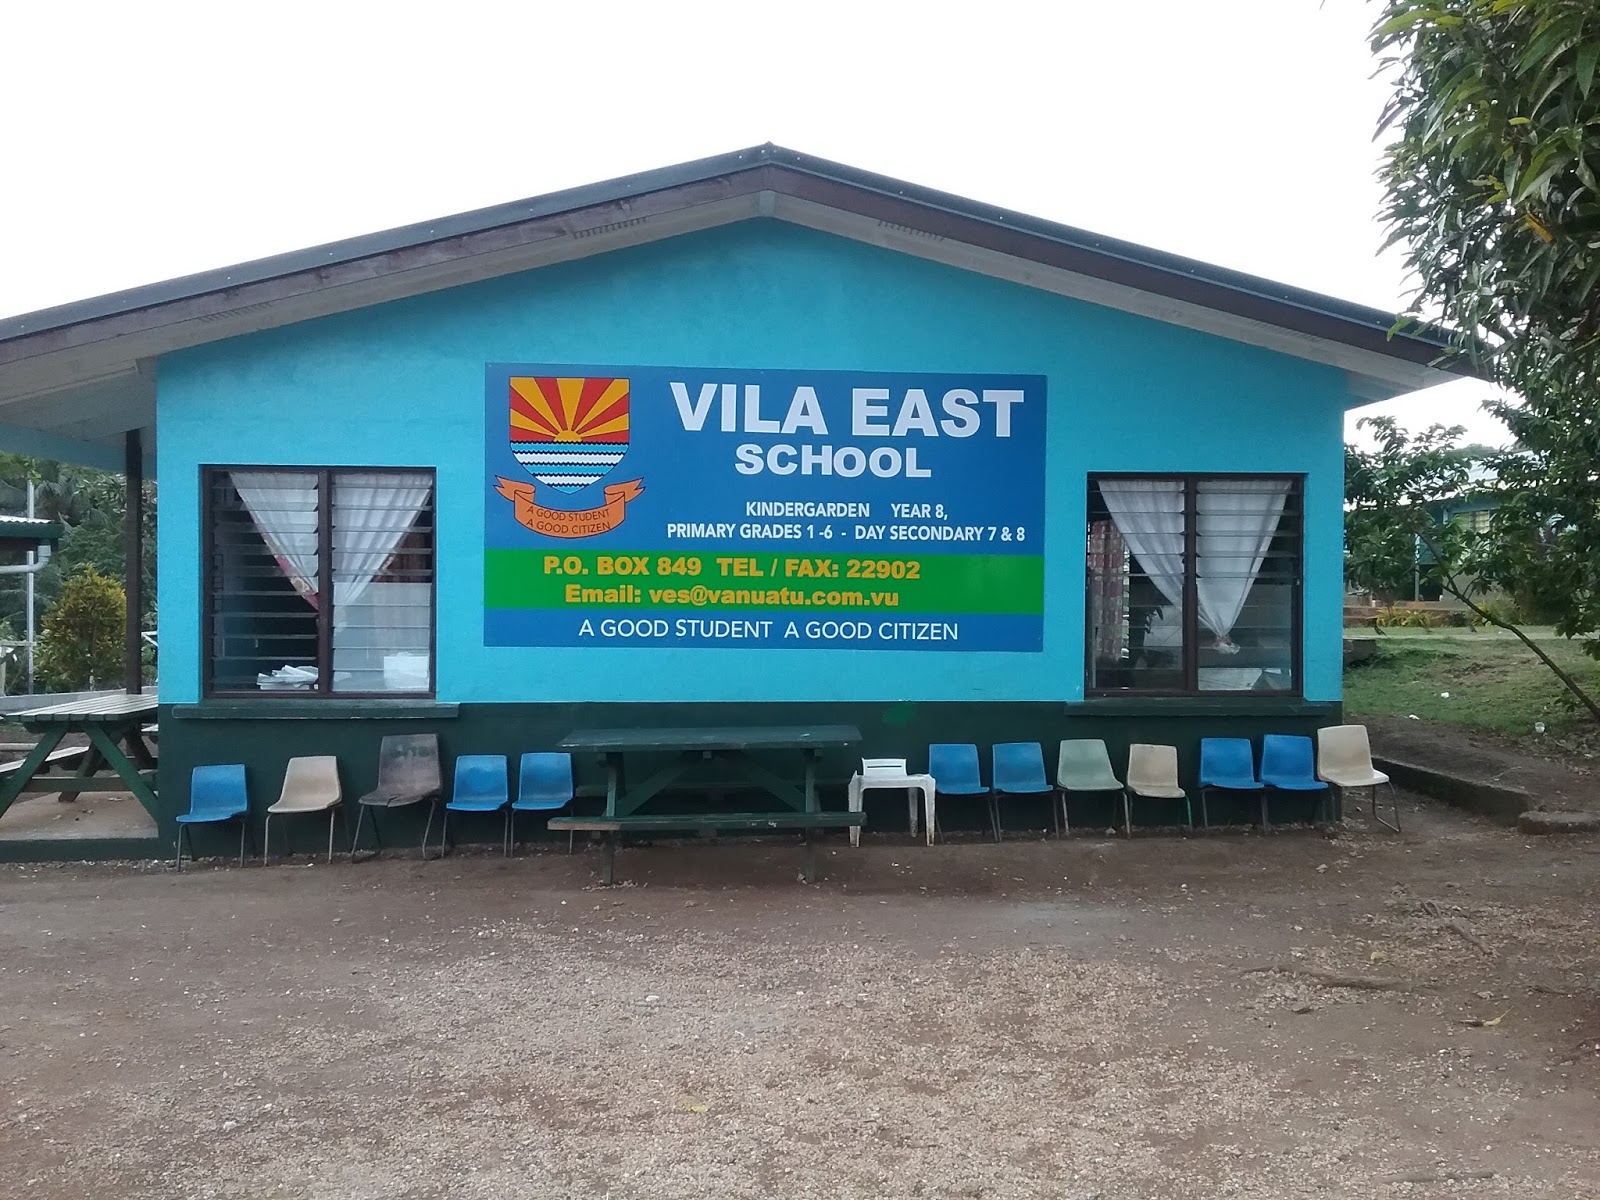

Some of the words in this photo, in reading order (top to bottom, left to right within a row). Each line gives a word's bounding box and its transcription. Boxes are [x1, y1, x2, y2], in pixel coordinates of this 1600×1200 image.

[670, 382, 828, 435] VILA
[852, 388, 1025, 437] EAST
[735, 443, 932, 478] SCHOOL
[526, 506, 535, 515] A
[536, 509, 566, 521] GOOD
[569, 508, 610, 521] STUDENT
[746, 501, 870, 518] KINDERGARDEN
[891, 503, 931, 518] YEAR
[935, 504, 948, 520] 8,
[526, 518, 534, 528] A
[536, 521, 569, 534] GOOD
[571, 521, 611, 535] CITIZEN
[667, 523, 736, 538] PRIMARY
[740, 523, 802, 539] GRADES
[855, 525, 886, 540] DAY
[889, 525, 984, 541] SECONDARY
[988, 526, 997, 541] 7
[1001, 526, 1013, 541] &
[1016, 526, 1026, 541] 8
[543, 555, 589, 575] P.O.
[597, 556, 650, 575] BOX
[657, 557, 702, 576] 849
[716, 558, 764, 577] TEL
[770, 558, 778, 577] /
[785, 559, 839, 578] FAX:
[846, 559, 921, 579] 22902
[565, 584, 641, 603] Email:
[648, 585, 899, 606] ves@vanuatu.com.vu
[578, 619, 595, 637] A
[600, 619, 669, 637] GOOD
[675, 619, 773, 638] STUDENT
[784, 621, 800, 639] A
[805, 622, 872, 639] GOOD
[878, 622, 958, 640] CITIZEN
